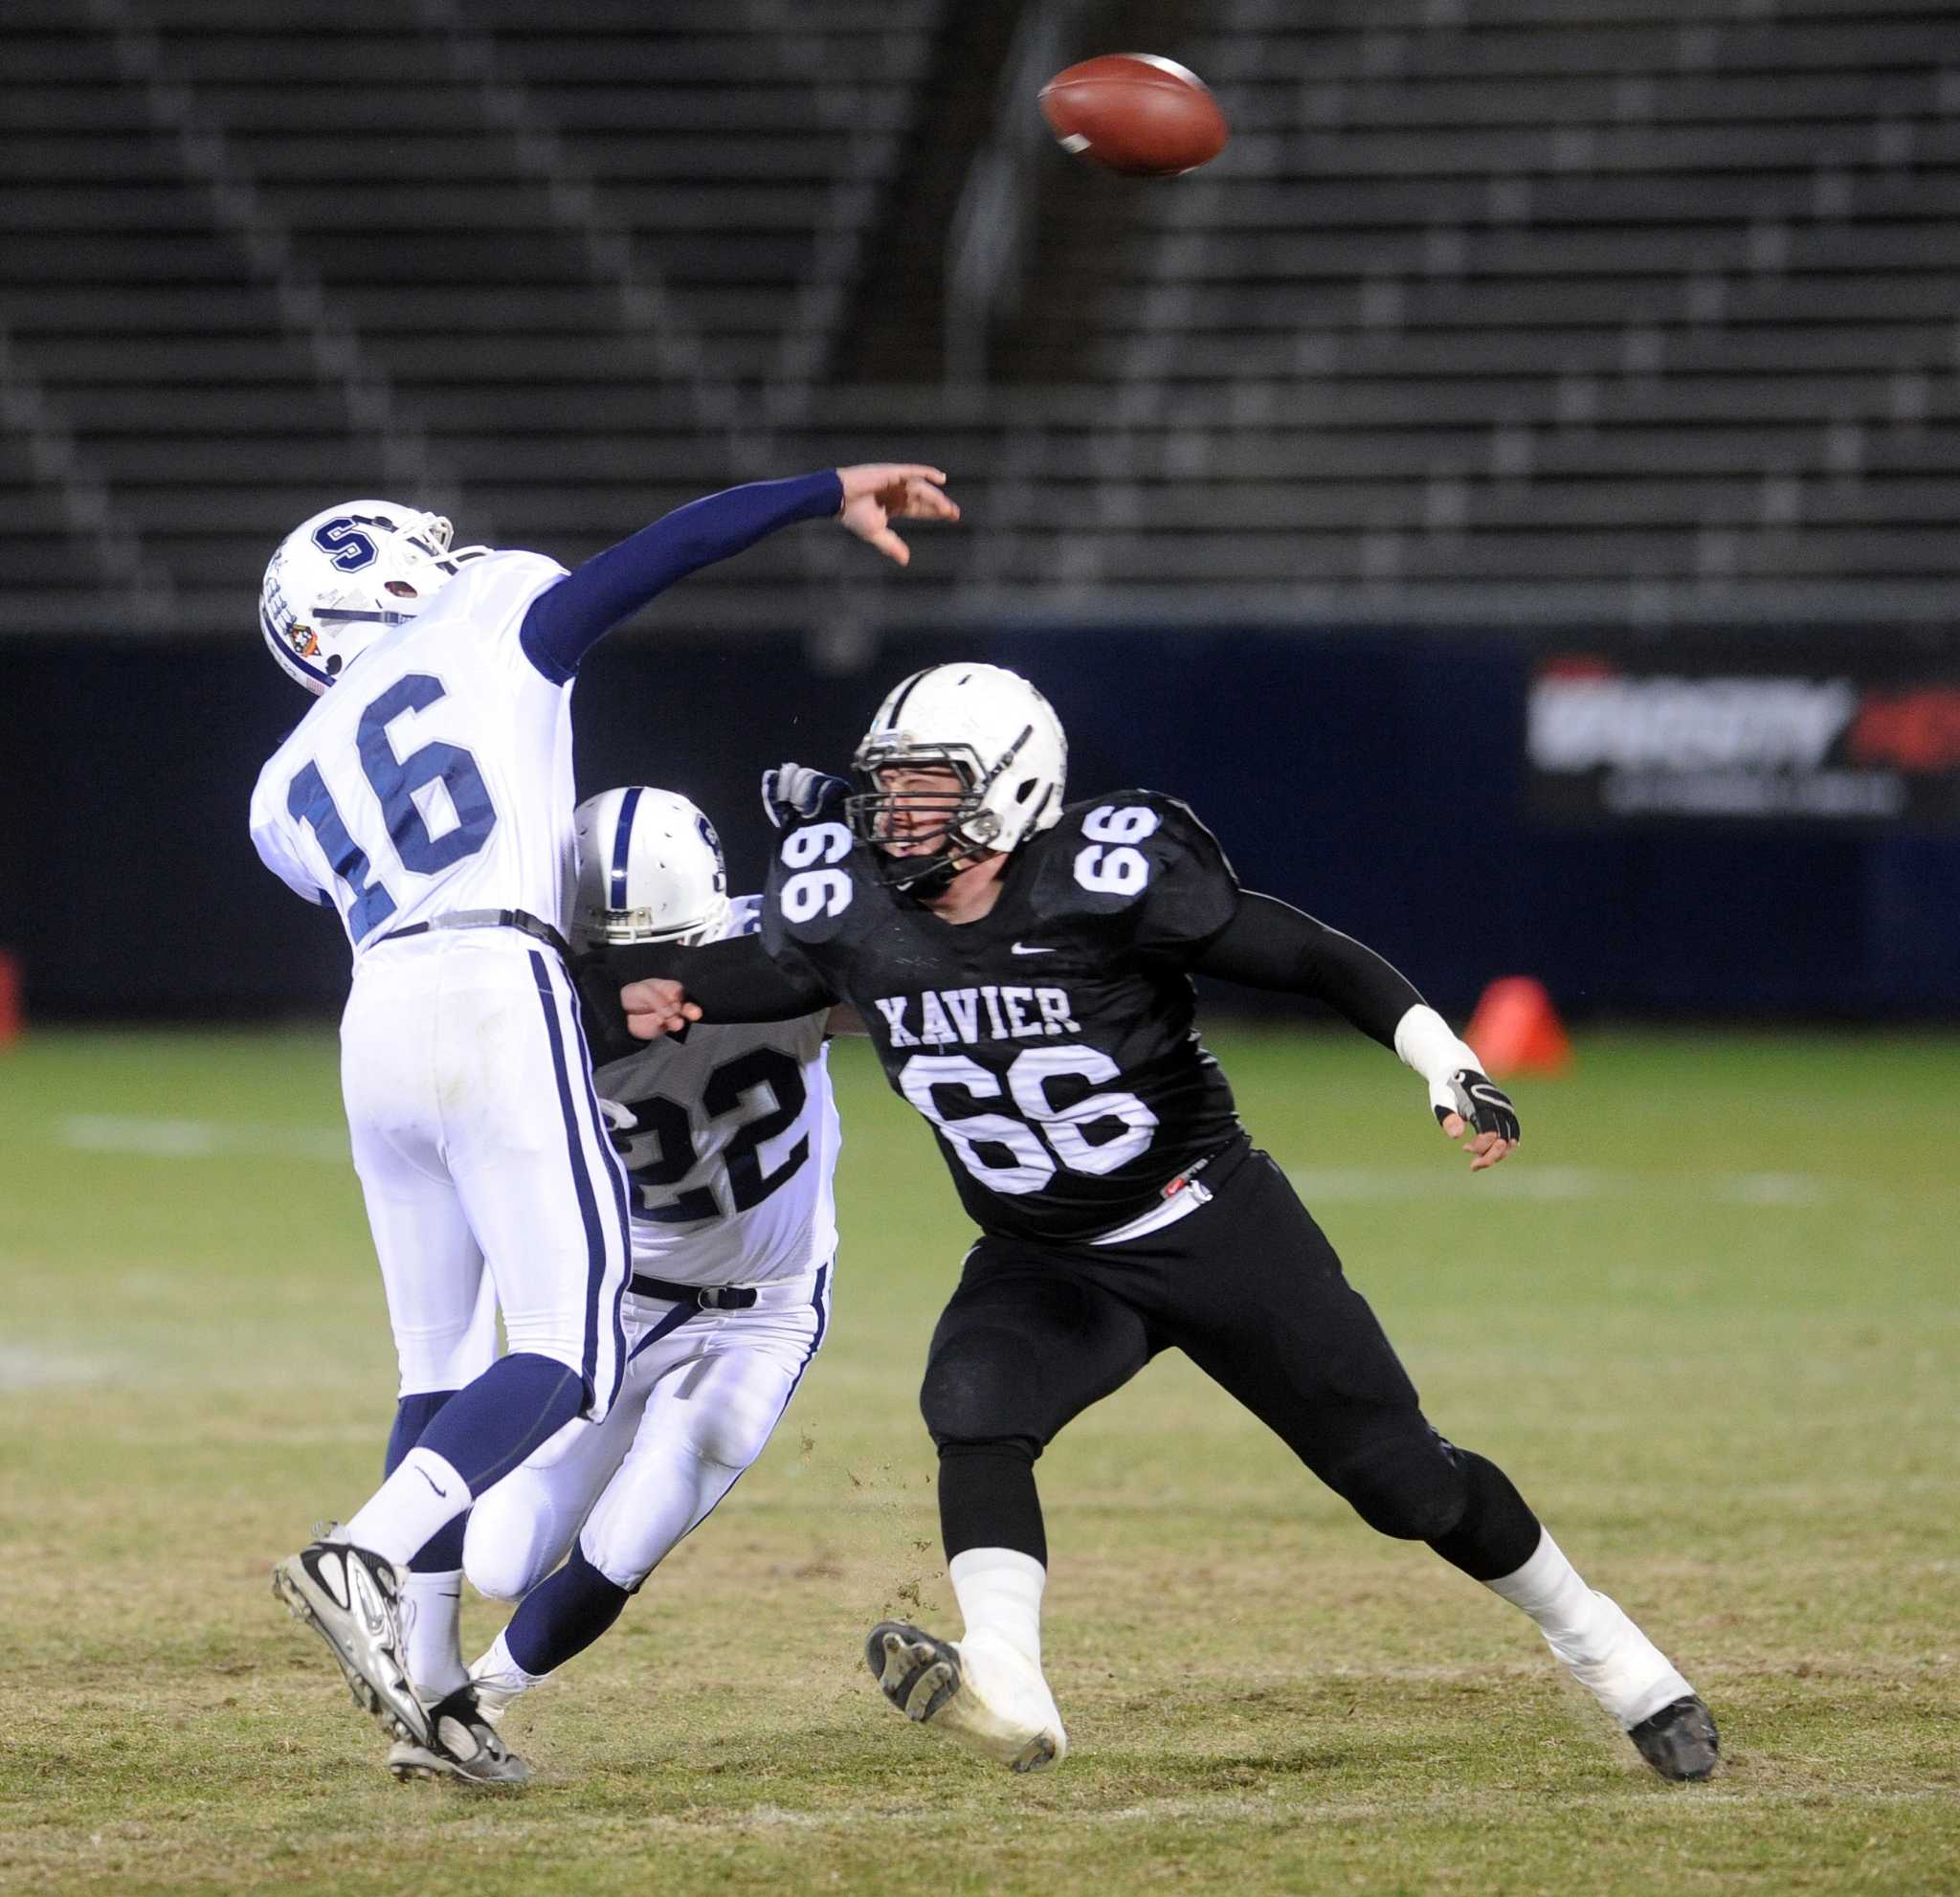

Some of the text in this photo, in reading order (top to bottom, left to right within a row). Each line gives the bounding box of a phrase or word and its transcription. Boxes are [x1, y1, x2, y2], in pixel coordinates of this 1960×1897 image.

[311, 517, 379, 573] S
[287, 673, 498, 946] 16
[1074, 805, 1158, 896] 66
[781, 822, 853, 924] 66
[875, 986, 1081, 1048] XAVIER
[612, 1047, 810, 1222] 22
[899, 1044, 1159, 1194] 66
